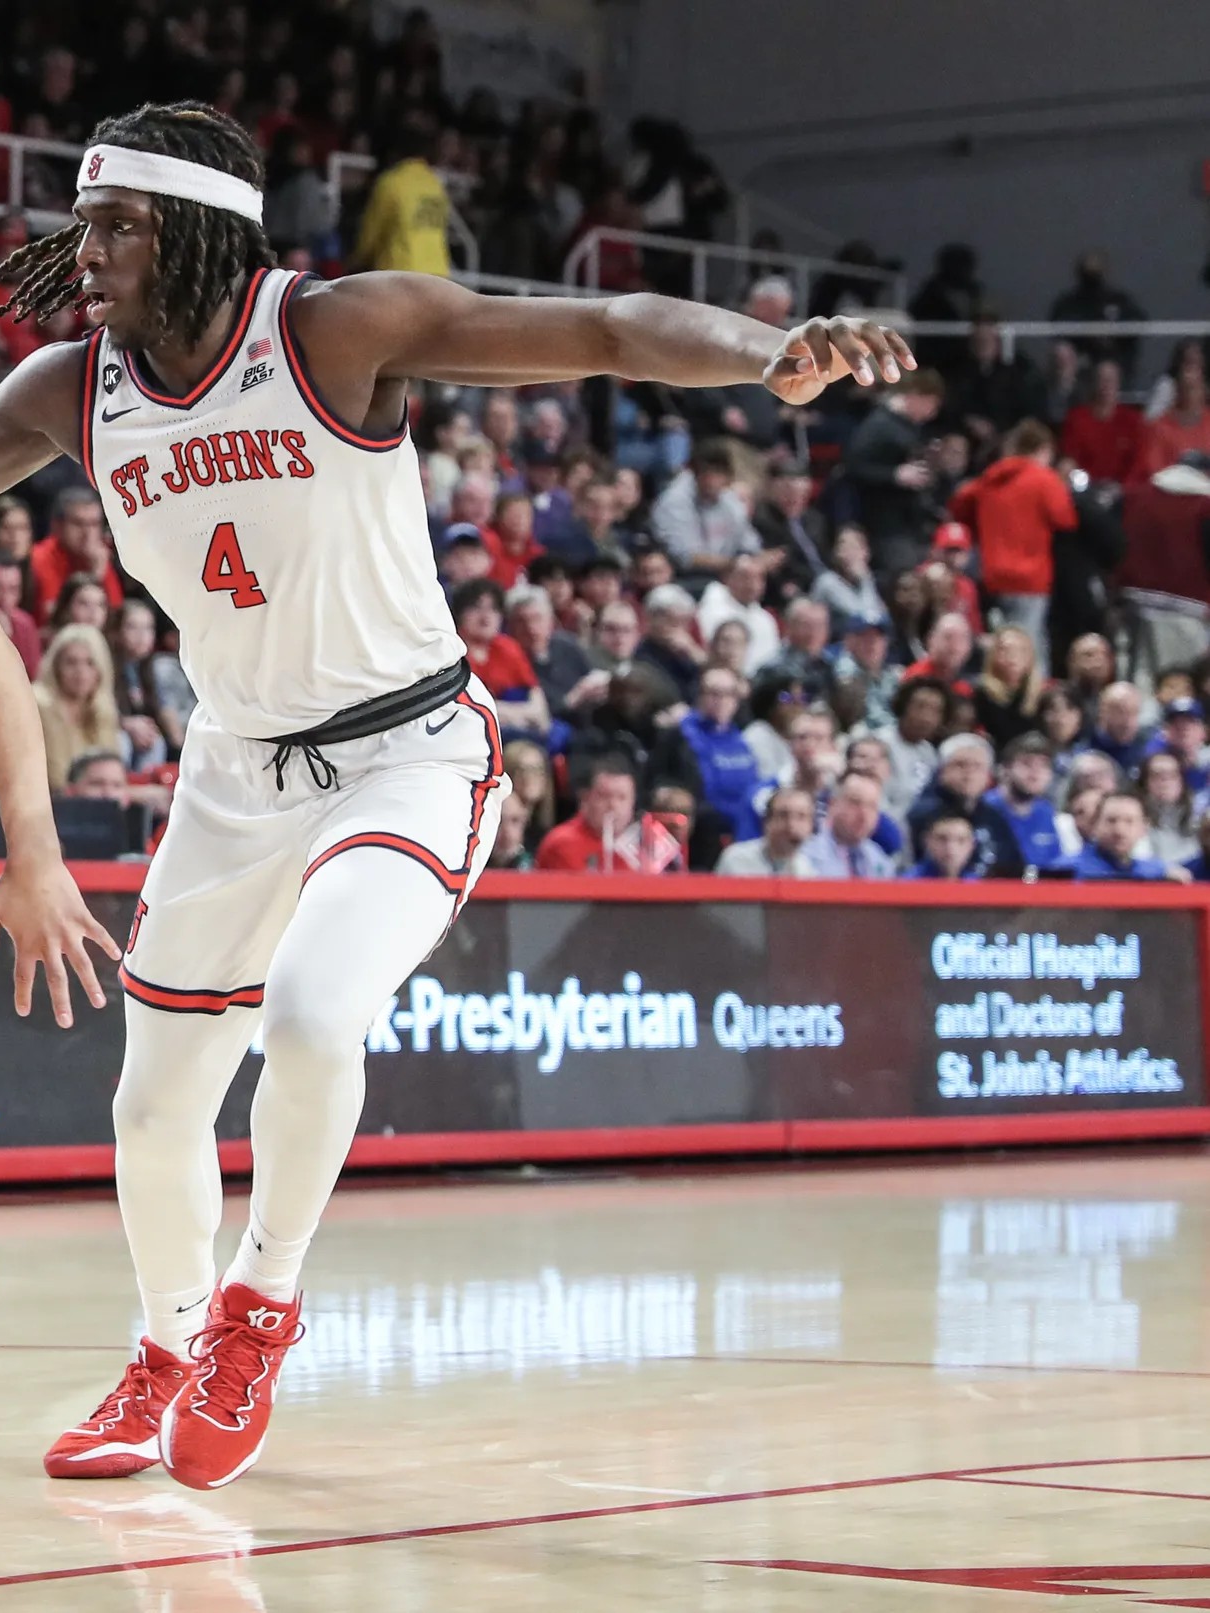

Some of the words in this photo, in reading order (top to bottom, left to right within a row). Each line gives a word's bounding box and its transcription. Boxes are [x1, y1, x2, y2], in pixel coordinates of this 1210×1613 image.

[104, 369, 119, 386] JK
[241, 367, 275, 388] EAST
[243, 362, 267, 379] BIG
[111, 455, 162, 518] ST.
[161, 429, 315, 494] JOHN'S
[201, 521, 268, 609] 4
[712, 991, 844, 1053] Queens
[935, 991, 988, 1039] and
[1093, 990, 1125, 1037] of
